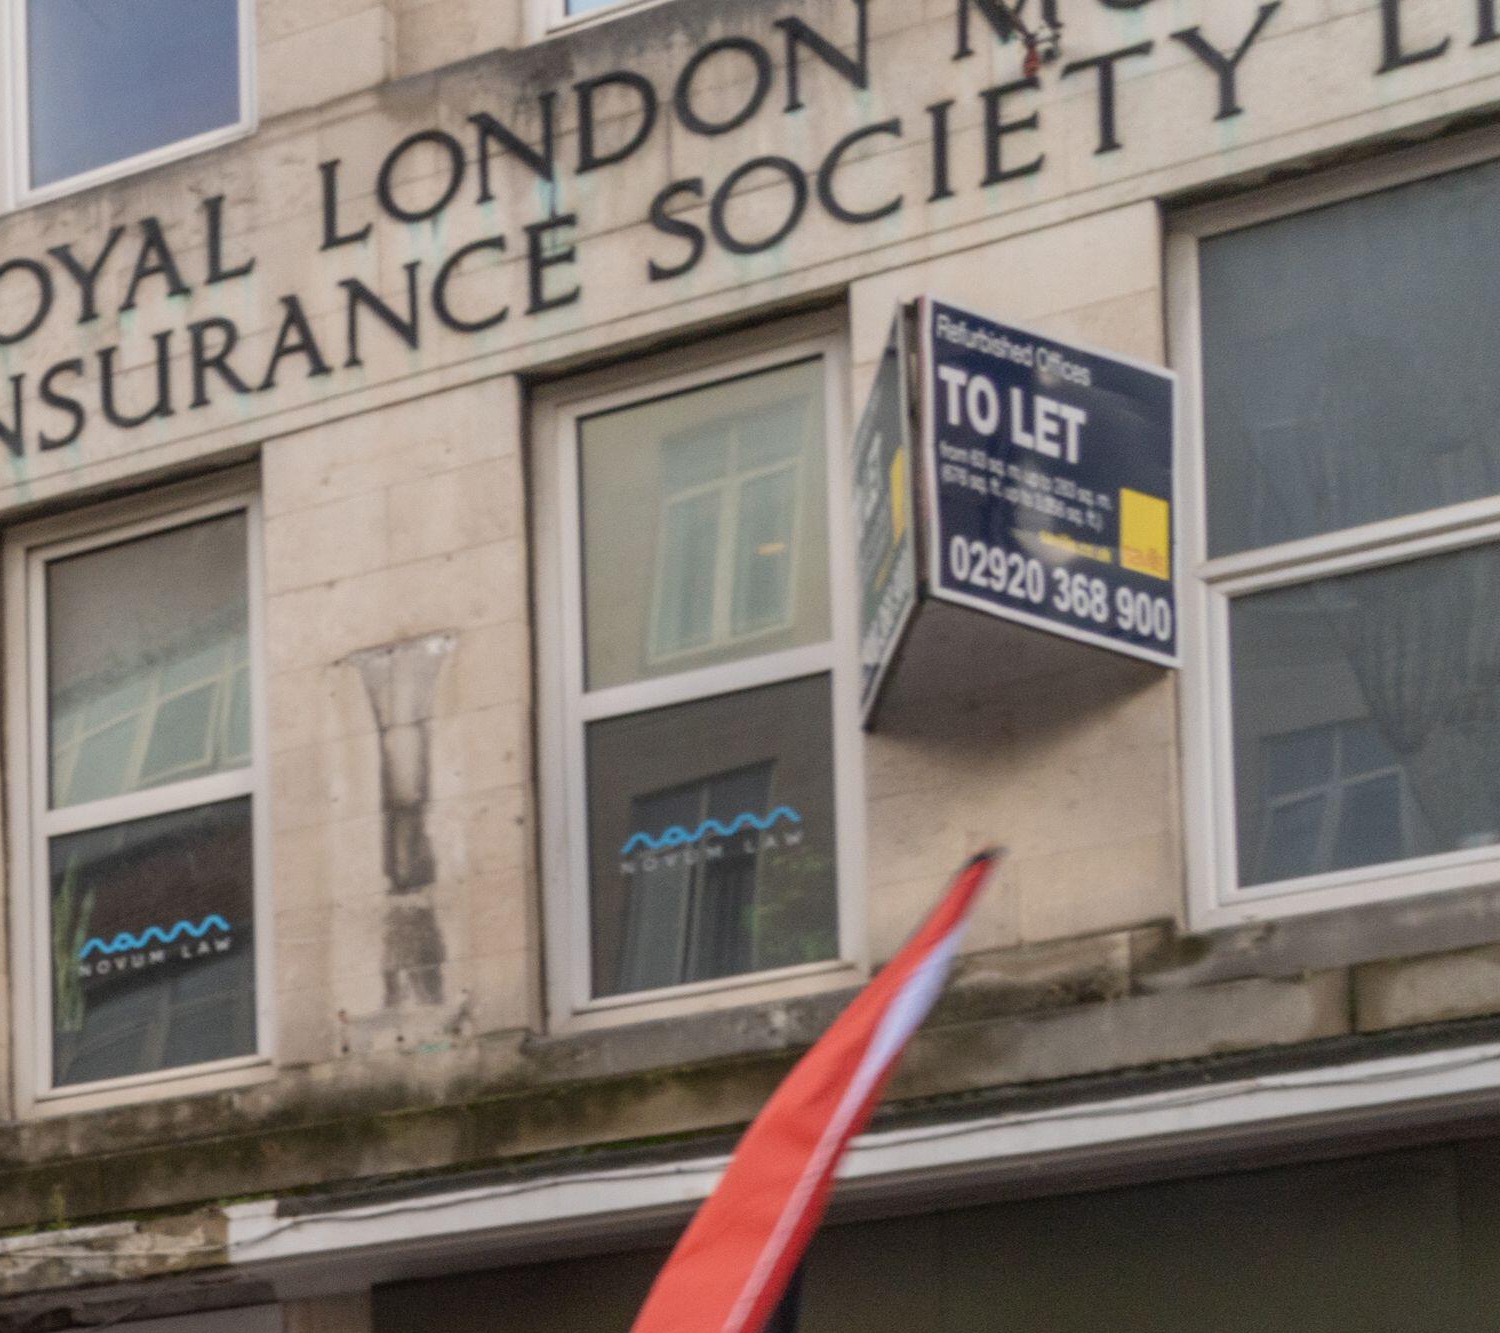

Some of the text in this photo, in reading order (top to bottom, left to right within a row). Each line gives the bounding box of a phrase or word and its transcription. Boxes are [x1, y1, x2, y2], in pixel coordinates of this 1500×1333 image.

[319, 0, 868, 250] LONDON
[648, 2, 1282, 281] SOCIETY
[939, 365, 1086, 464] TO LET
[951, 535, 1046, 604] 02920
[1052, 567, 1108, 623] 368
[1116, 586, 1172, 641] 900
[80, 938, 231, 977] NOVUM LAW
